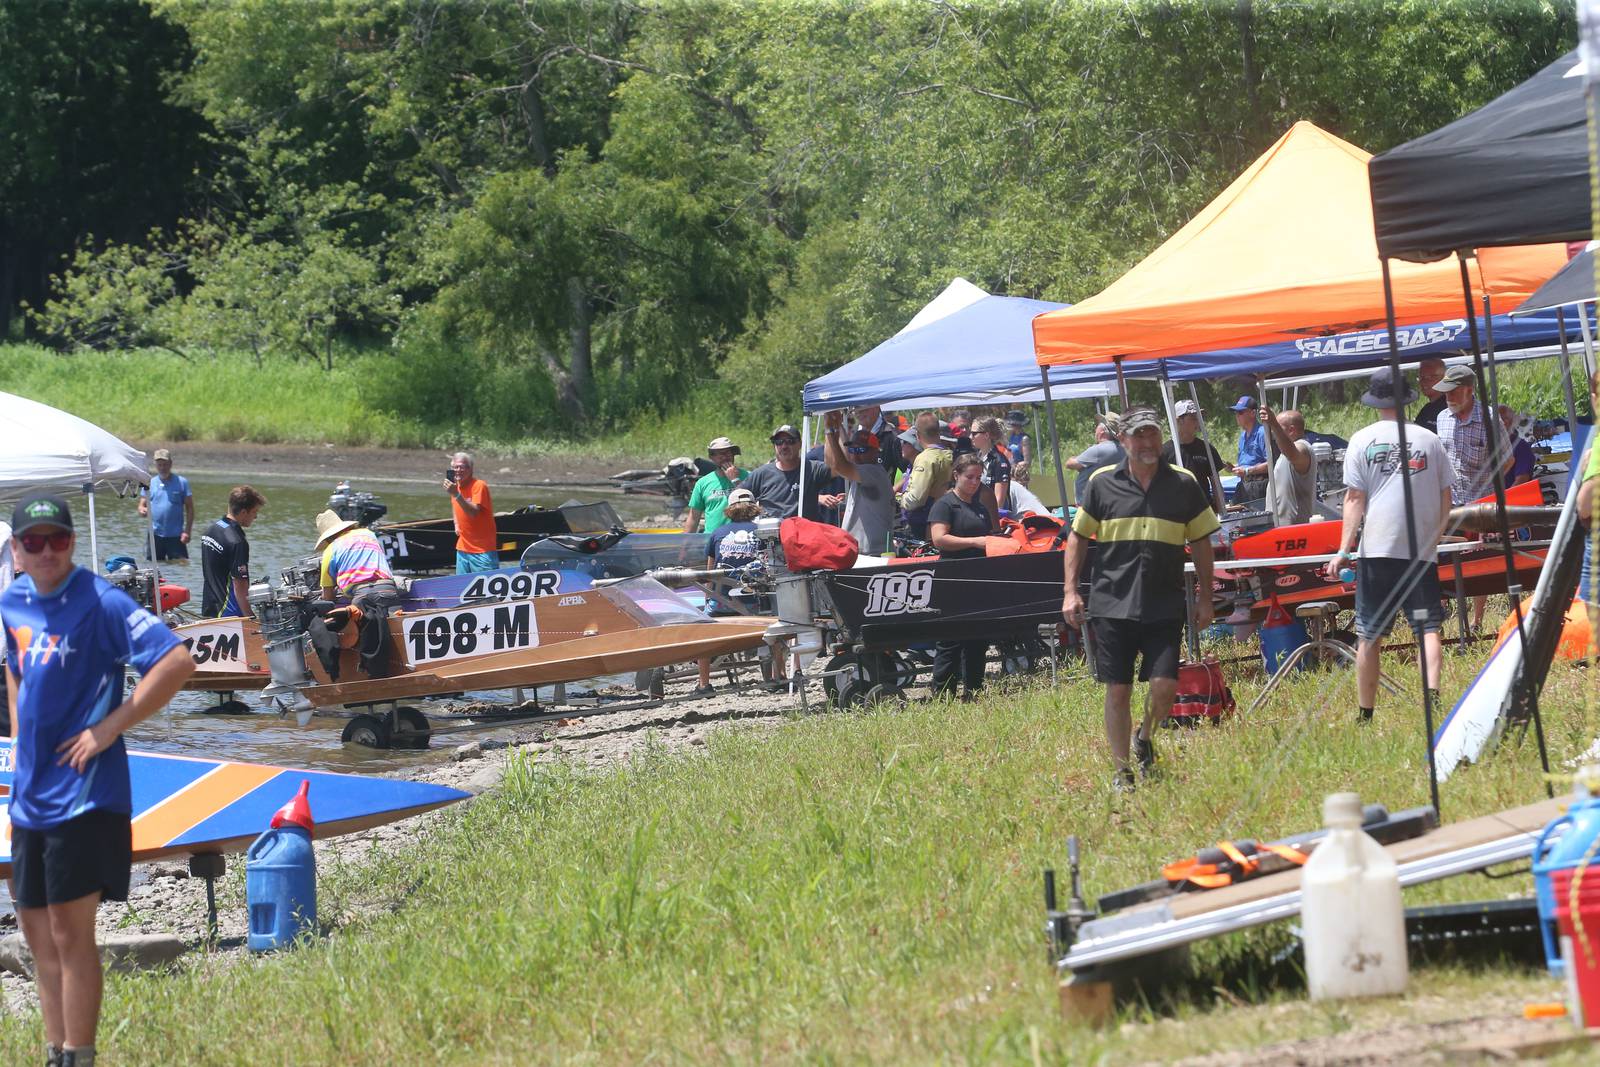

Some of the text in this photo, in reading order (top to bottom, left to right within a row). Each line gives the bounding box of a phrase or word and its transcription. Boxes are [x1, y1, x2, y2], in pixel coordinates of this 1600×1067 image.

[1297, 319, 1466, 359] RACECRAFT
[1275, 538, 1307, 552] TBR
[460, 571, 561, 603] 499R
[864, 569, 936, 617] 199
